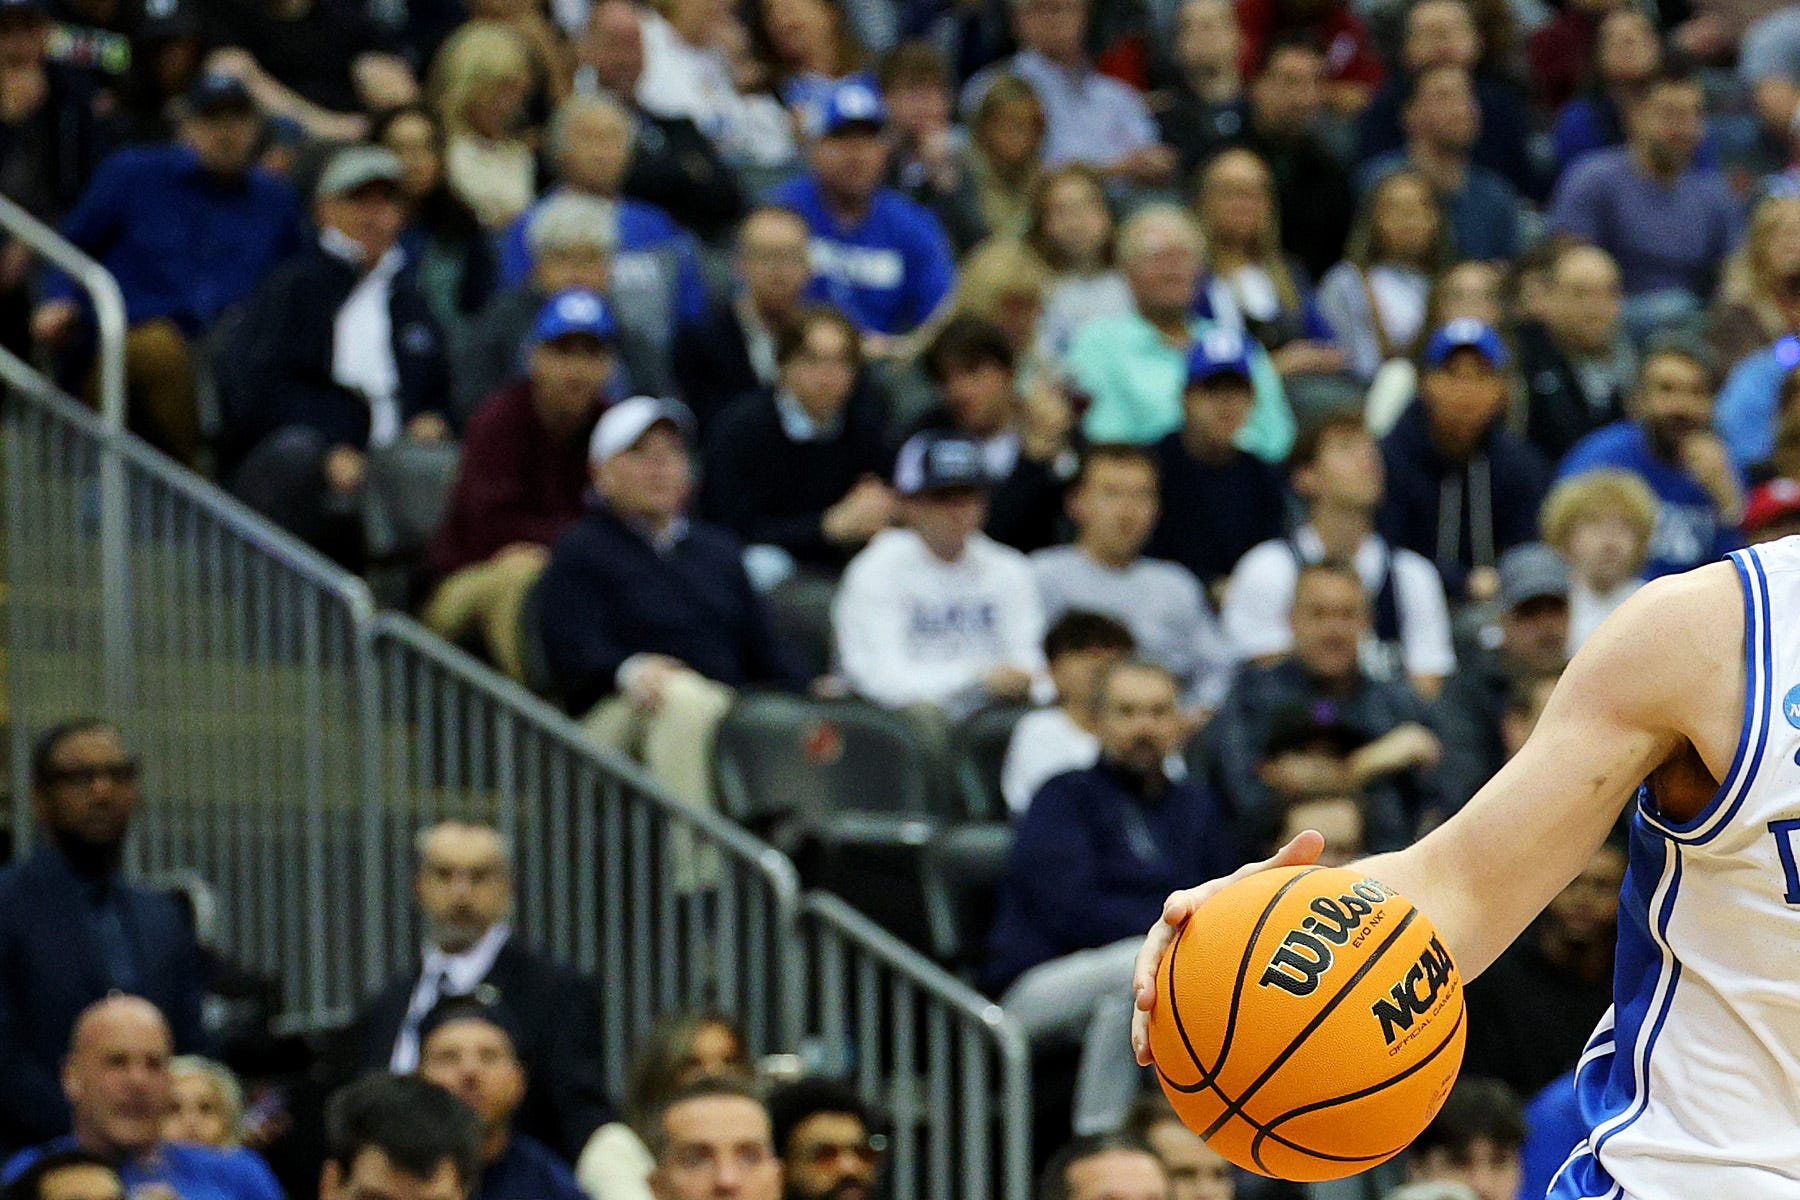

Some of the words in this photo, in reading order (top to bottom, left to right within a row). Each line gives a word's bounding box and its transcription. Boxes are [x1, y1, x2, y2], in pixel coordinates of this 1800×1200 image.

[1352, 926, 1371, 949] EVO
[1369, 909, 1386, 928] NXT
[1371, 932, 1454, 1046] NCAA
